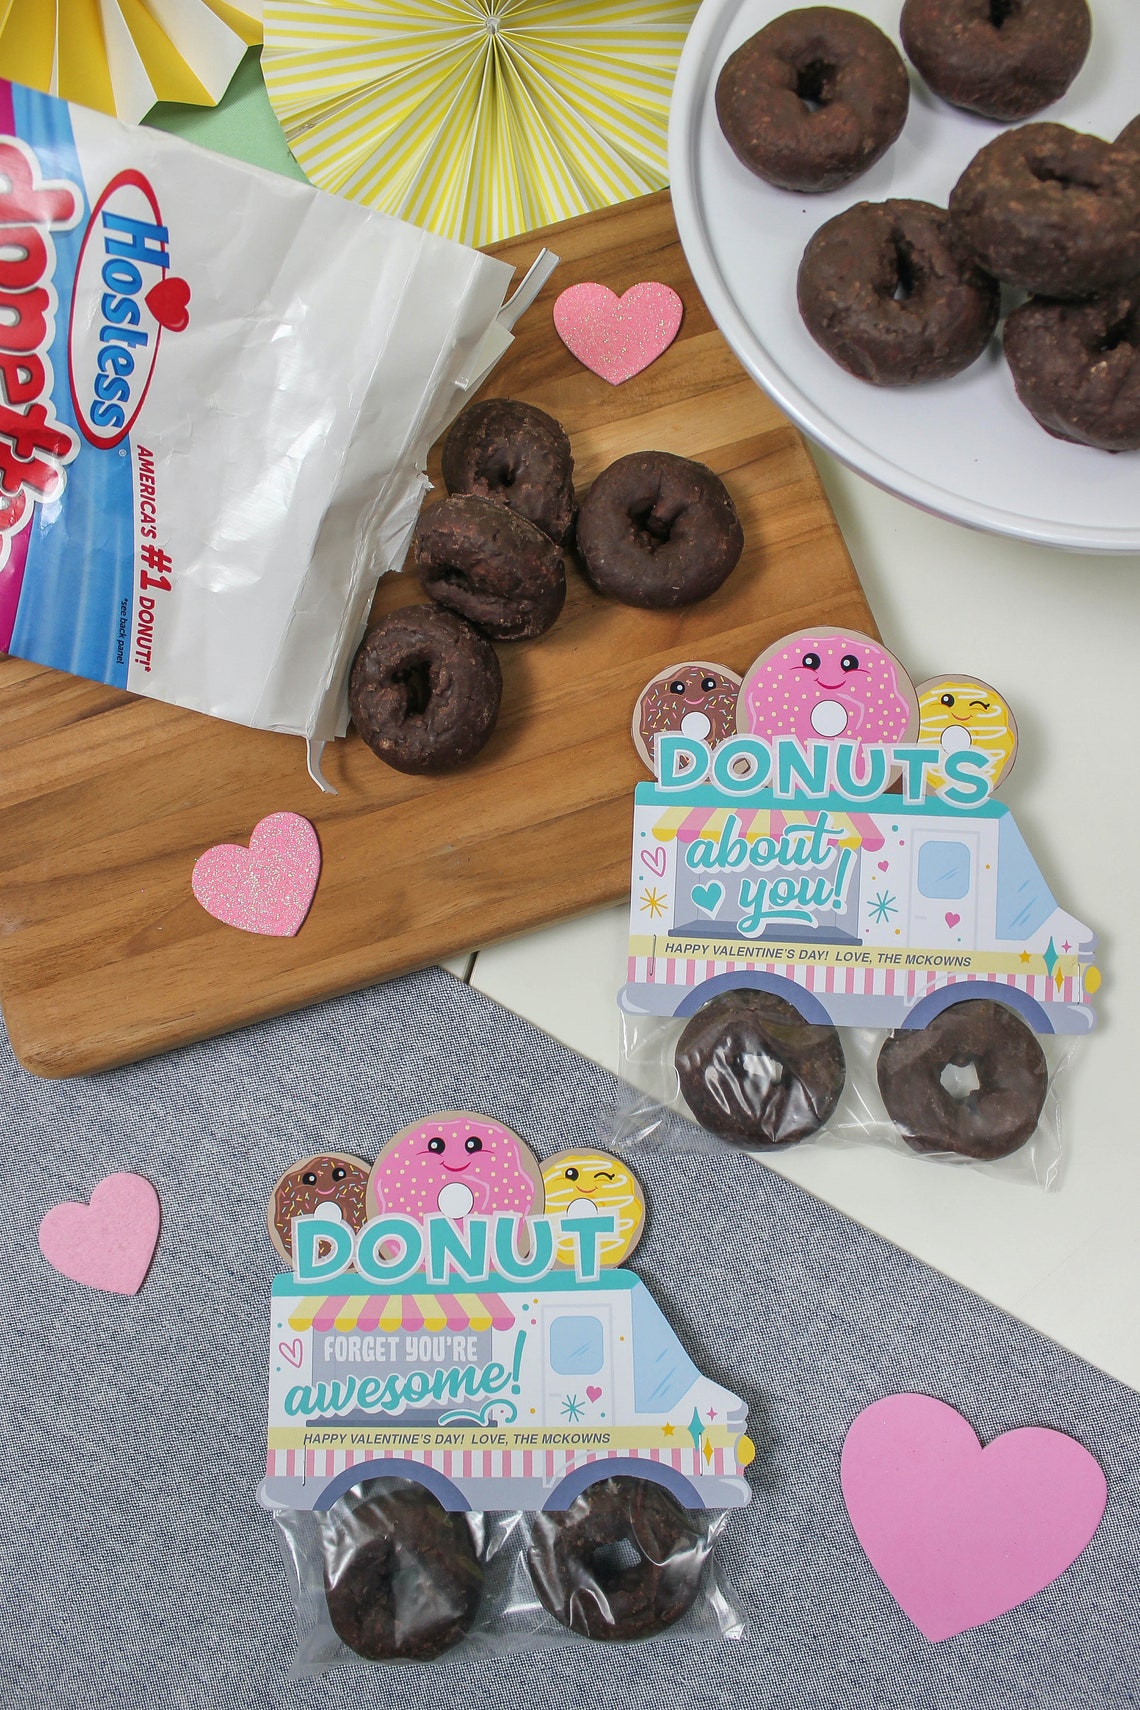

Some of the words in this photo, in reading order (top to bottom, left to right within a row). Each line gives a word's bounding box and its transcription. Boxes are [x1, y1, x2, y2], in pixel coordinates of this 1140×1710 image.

[89, 209, 171, 430] Hostess
[136, 443, 158, 540] AMERICA'S
[138, 543, 173, 592] #1
[115, 638, 125, 665] panel
[118, 616, 129, 639] back
[656, 734, 995, 807] DONUTS
[686, 810, 844, 871] about
[737, 847, 852, 934] you!
[665, 942, 709, 955] HAPPY
[712, 945, 796, 959] VALENTINE'S
[798, 949, 830, 961] DAY!
[835, 951, 873, 964] LOVE,
[876, 953, 903, 964] THE
[905, 954, 972, 967] MCKOWNS
[293, 1215, 615, 1283] DONUT
[284, 1329, 527, 1417] awesome!
[323, 1335, 400, 1363] FORGET
[404, 1335, 479, 1363] YOU'RE
[303, 1433, 347, 1445] HAPPY
[349, 1433, 432, 1445] VALENTINE'S
[434, 1433, 465, 1445] DAY!
[471, 1433, 509, 1446] LOVE,
[513, 1433, 539, 1444] THE
[541, 1433, 611, 1445] MCKOWNS
